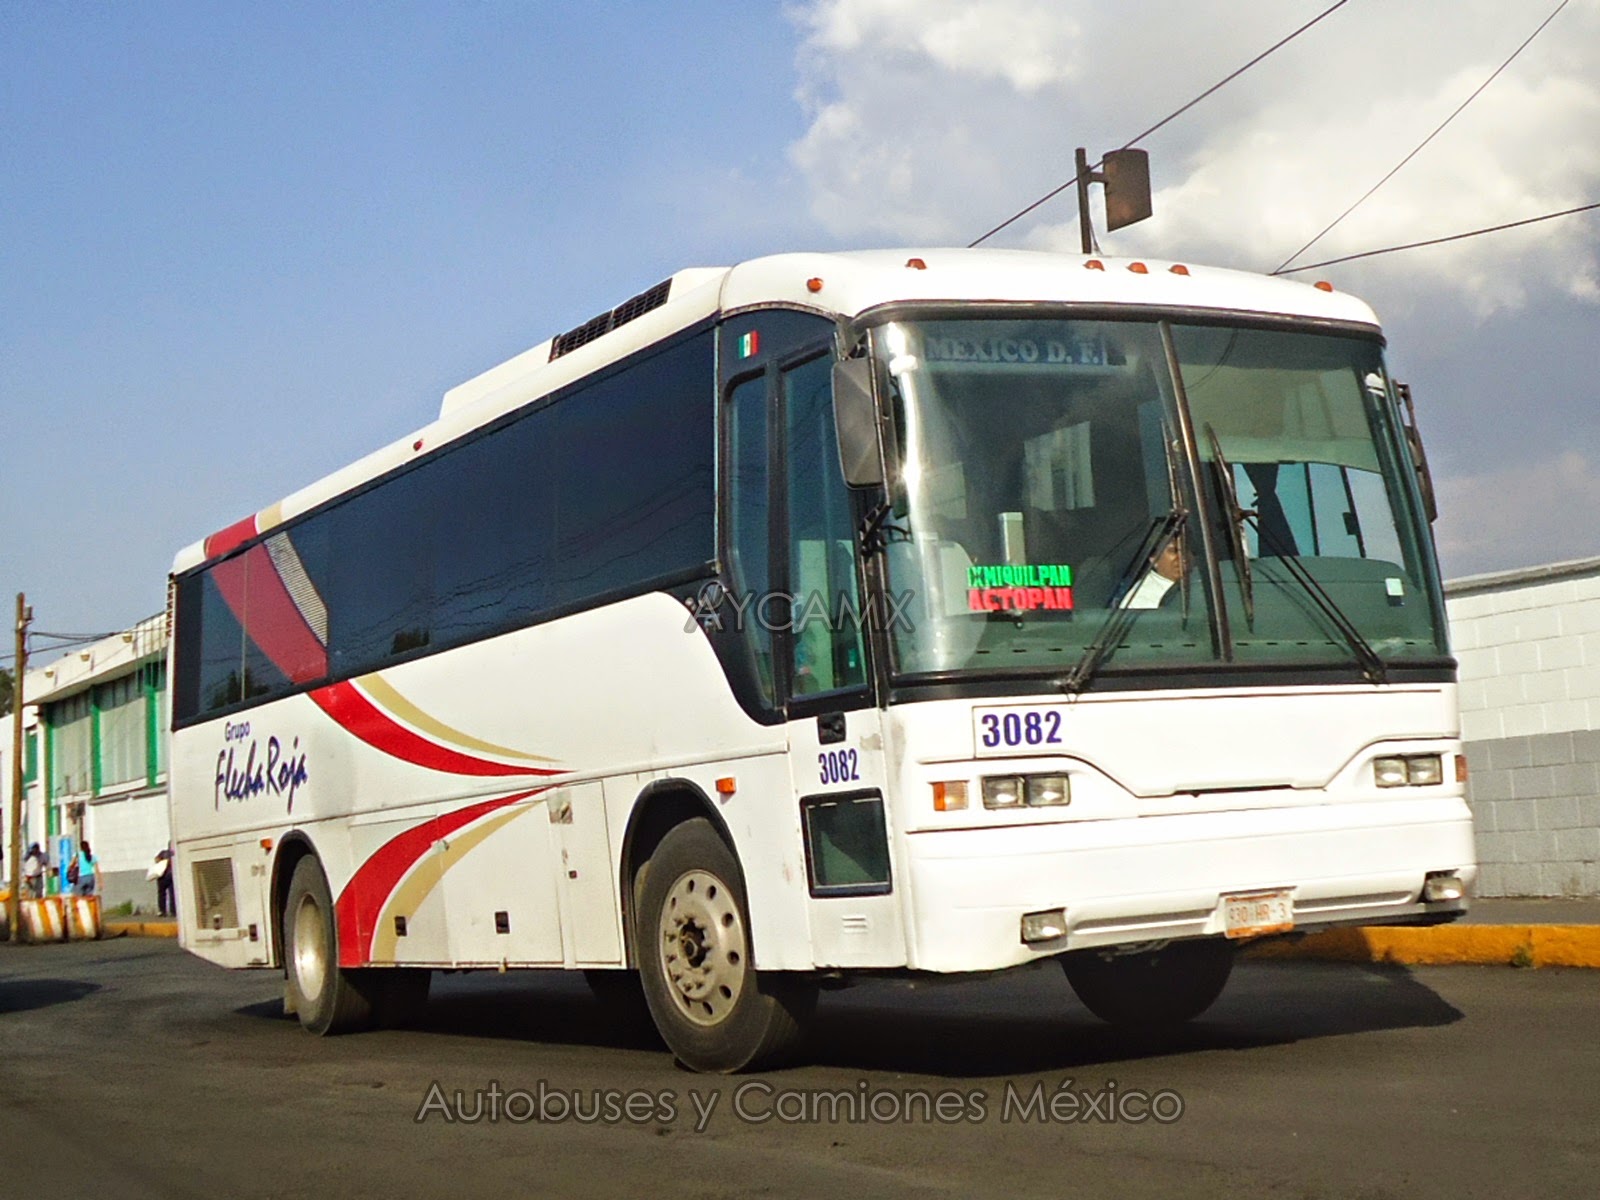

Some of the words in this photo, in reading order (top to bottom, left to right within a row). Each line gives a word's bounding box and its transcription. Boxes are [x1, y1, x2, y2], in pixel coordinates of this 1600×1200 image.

[926, 338, 1039, 361] MEXICO
[967, 565, 1072, 587] IXMIQUILPAN
[968, 587, 1074, 610] ACTOPAN
[225, 721, 250, 743] Grupo
[981, 711, 1062, 747] 3082
[818, 748, 860, 785] 3082
